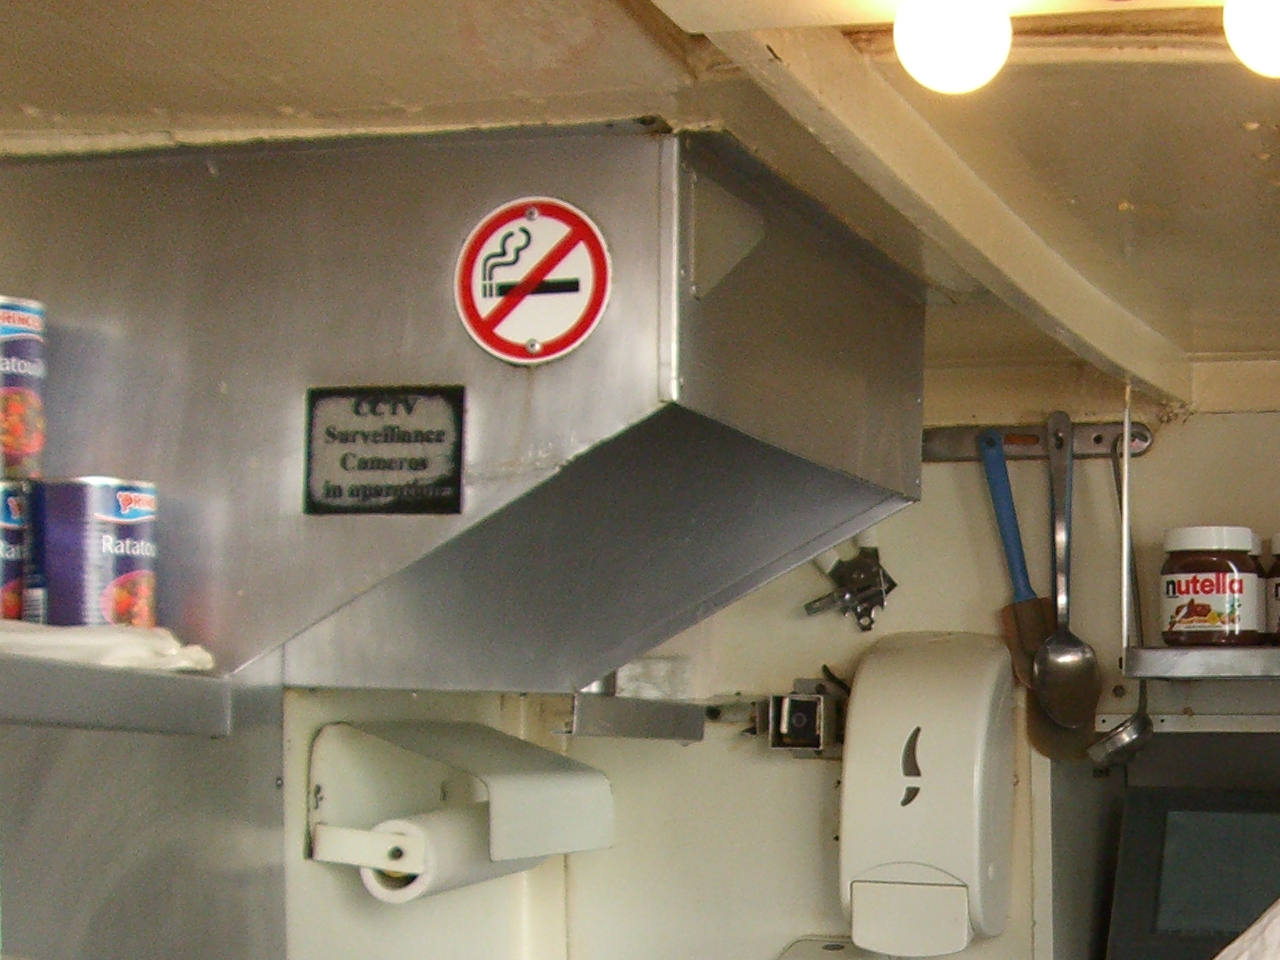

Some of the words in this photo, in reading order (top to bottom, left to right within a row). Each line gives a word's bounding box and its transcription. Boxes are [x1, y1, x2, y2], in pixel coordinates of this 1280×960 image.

[323, 424, 446, 444] Surveillance
[339, 451, 430, 471] Cameras
[322, 480, 343, 498] in
[1165, 572, 1244, 597] nutella
